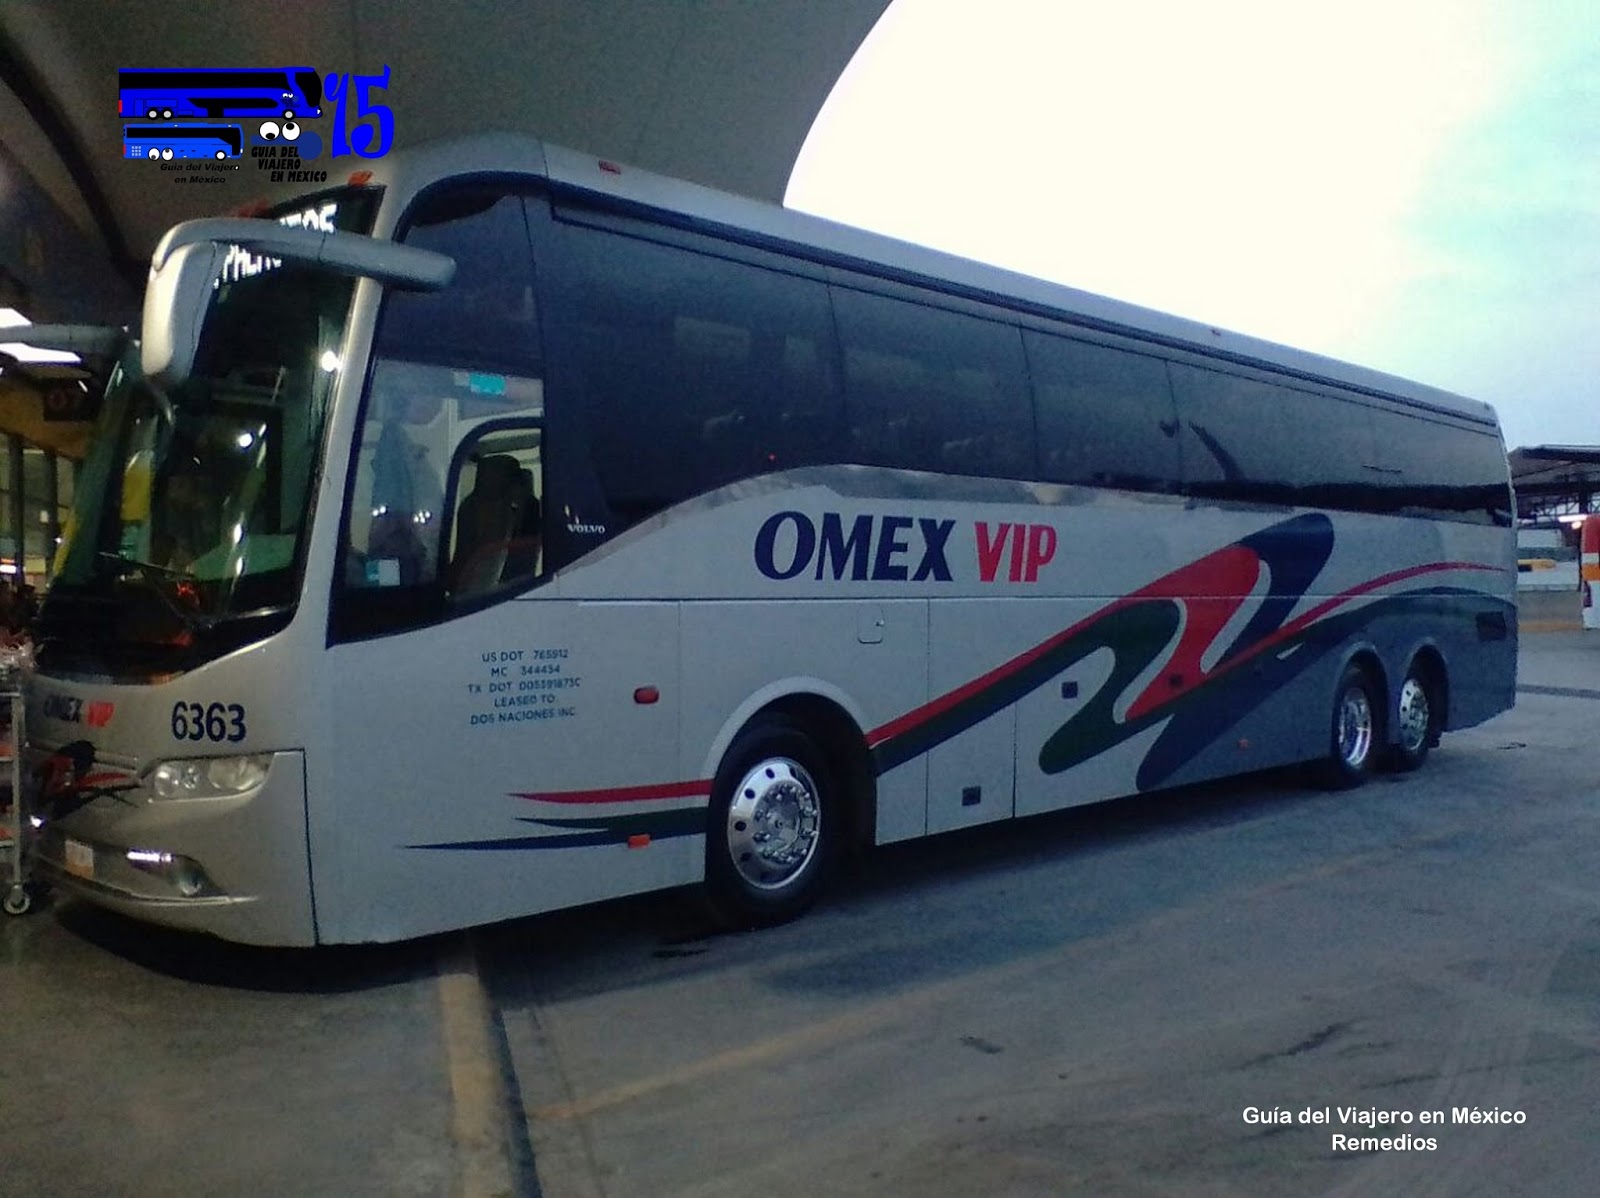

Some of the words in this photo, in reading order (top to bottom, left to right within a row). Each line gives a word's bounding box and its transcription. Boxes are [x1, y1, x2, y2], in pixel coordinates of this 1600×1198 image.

[567, 523, 606, 534] VOLVO
[754, 510, 957, 582] OMEX
[974, 520, 1058, 583] VIP
[482, 651, 498, 662] US
[500, 650, 525, 662] DOT
[491, 667, 508, 677] MC
[467, 683, 482, 694] TX
[489, 682, 513, 693] DOT
[494, 694, 538, 708] LEASED
[542, 693, 556, 704] TO
[171, 701, 247, 742] 6363
[470, 713, 495, 725] DOS
[499, 708, 556, 723] NACIONES
[558, 706, 577, 717] INC
